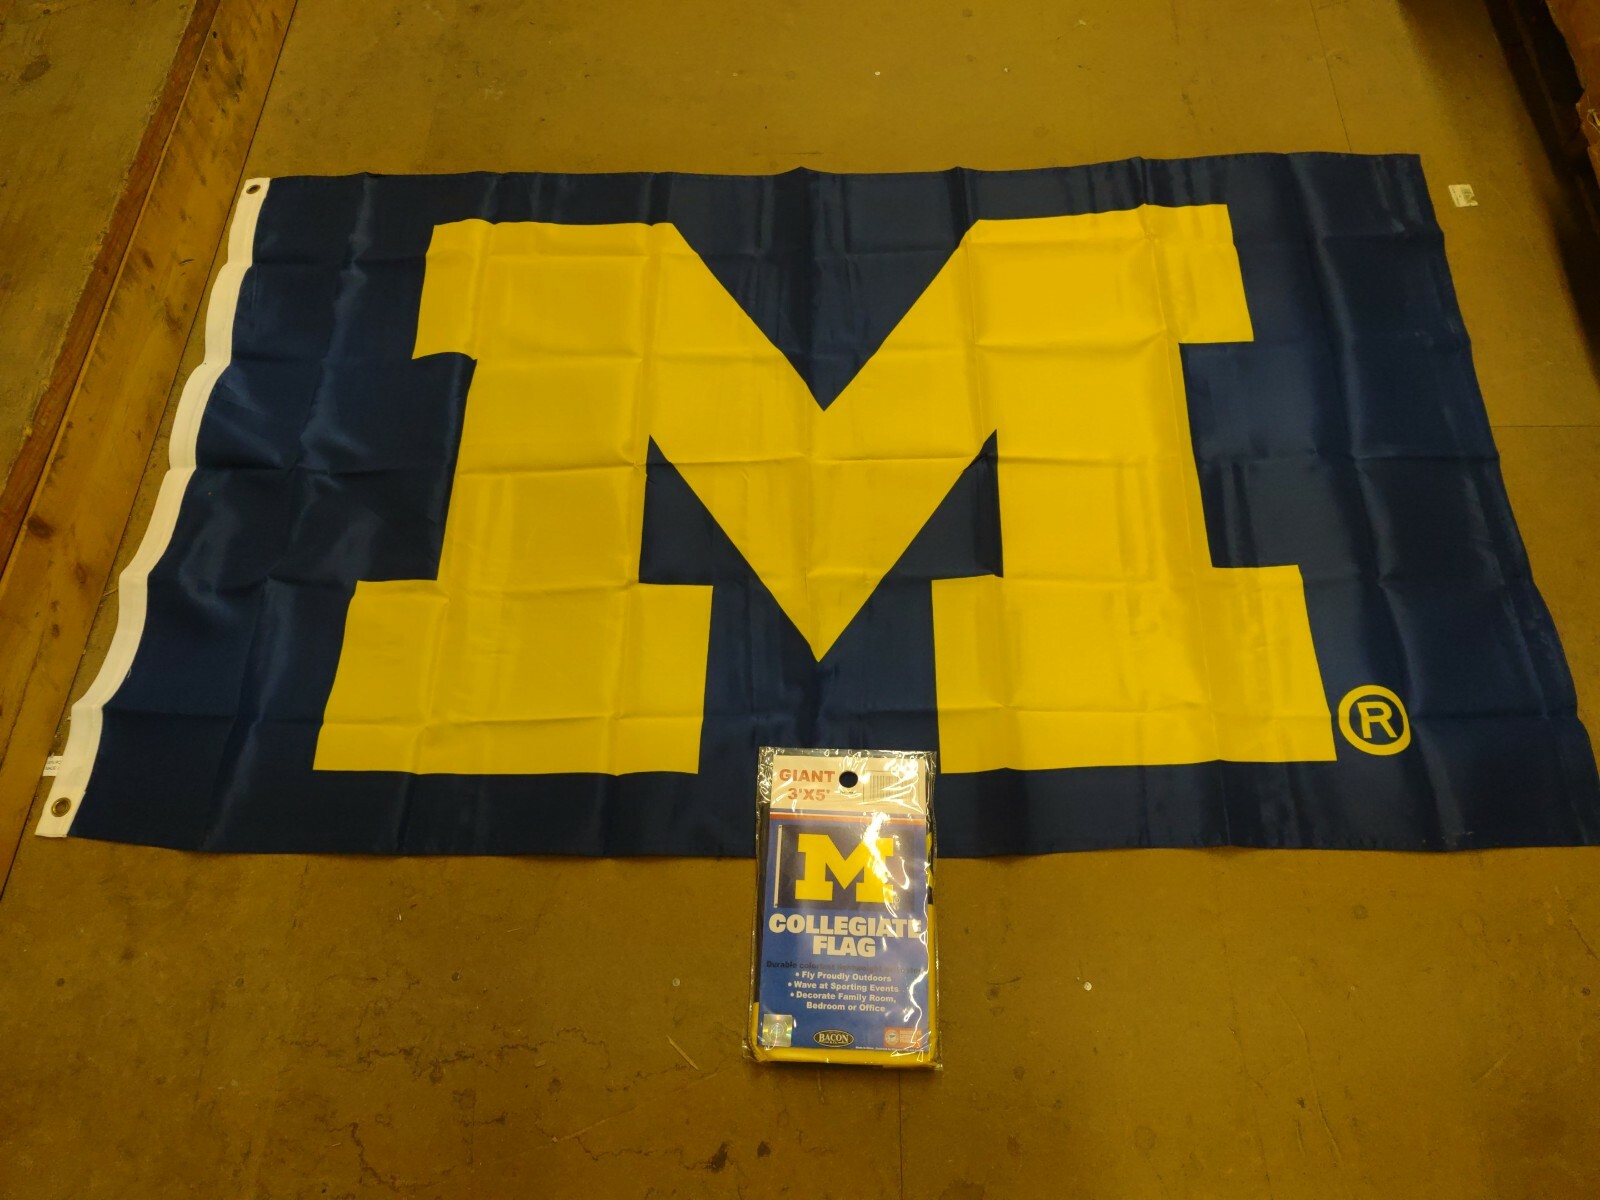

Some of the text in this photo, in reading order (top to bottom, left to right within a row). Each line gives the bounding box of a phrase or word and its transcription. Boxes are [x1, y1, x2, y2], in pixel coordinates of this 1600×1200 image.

[313, 203, 1337, 776] M
[779, 768, 836, 783] GIANT
[787, 787, 831, 801] 3'X5'
[794, 833, 894, 904] M
[768, 913, 922, 939] COLLEGIATE
[812, 935, 876, 958] FLAG
[766, 960, 798, 969] Durable
[801, 970, 892, 983] Fly Proudly Outdoors
[794, 981, 899, 993] Wave at Sporting Events
[796, 991, 897, 1004] Decorate Family Room,
[806, 1001, 846, 1011] Bedroom
[859, 1003, 886, 1012] Office
[818, 1032, 849, 1043] BACON
